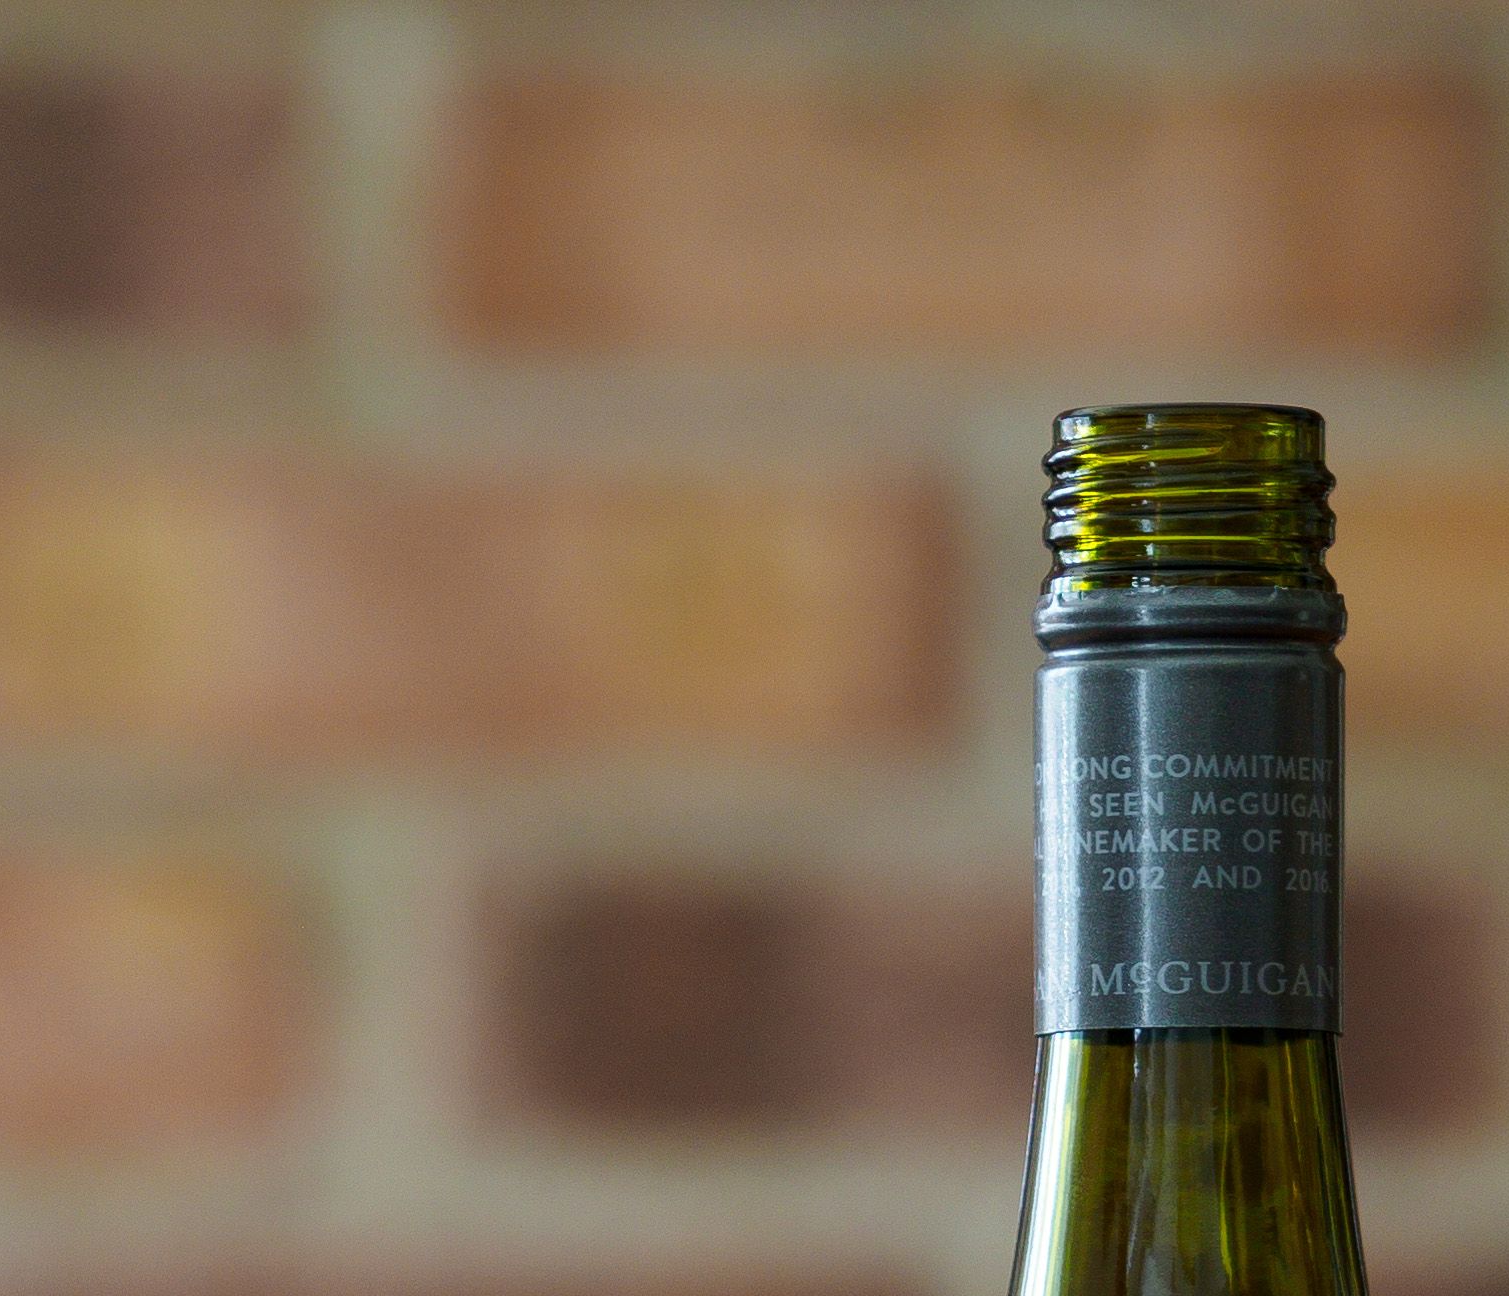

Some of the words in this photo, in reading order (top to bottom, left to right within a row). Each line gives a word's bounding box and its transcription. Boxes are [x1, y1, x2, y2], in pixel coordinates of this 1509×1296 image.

[1142, 753, 1334, 783] COMMITMENT
[1090, 791, 1165, 818] SEEN
[1190, 791, 1333, 820] McGUIGAN
[1242, 828, 1283, 853] OF
[1297, 830, 1334, 856] THE
[1102, 866, 1166, 891] 2012
[1192, 865, 1262, 890] AND
